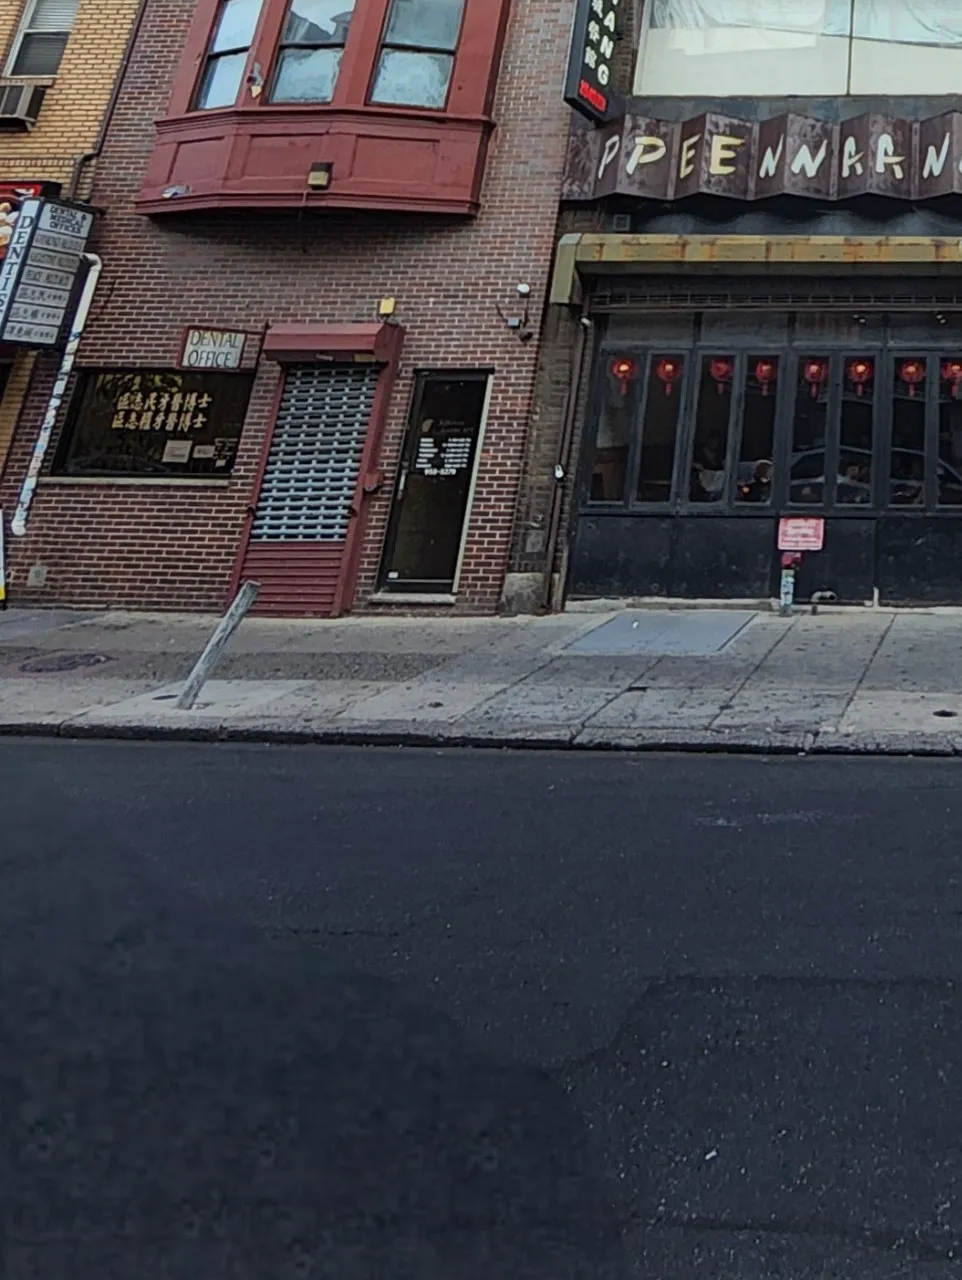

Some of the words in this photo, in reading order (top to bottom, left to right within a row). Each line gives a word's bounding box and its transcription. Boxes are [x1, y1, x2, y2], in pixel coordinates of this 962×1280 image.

[0, 215, 34, 313] DENTIS
[190, 330, 238, 349] DENTAL
[187, 350, 232, 367] OFFICE
